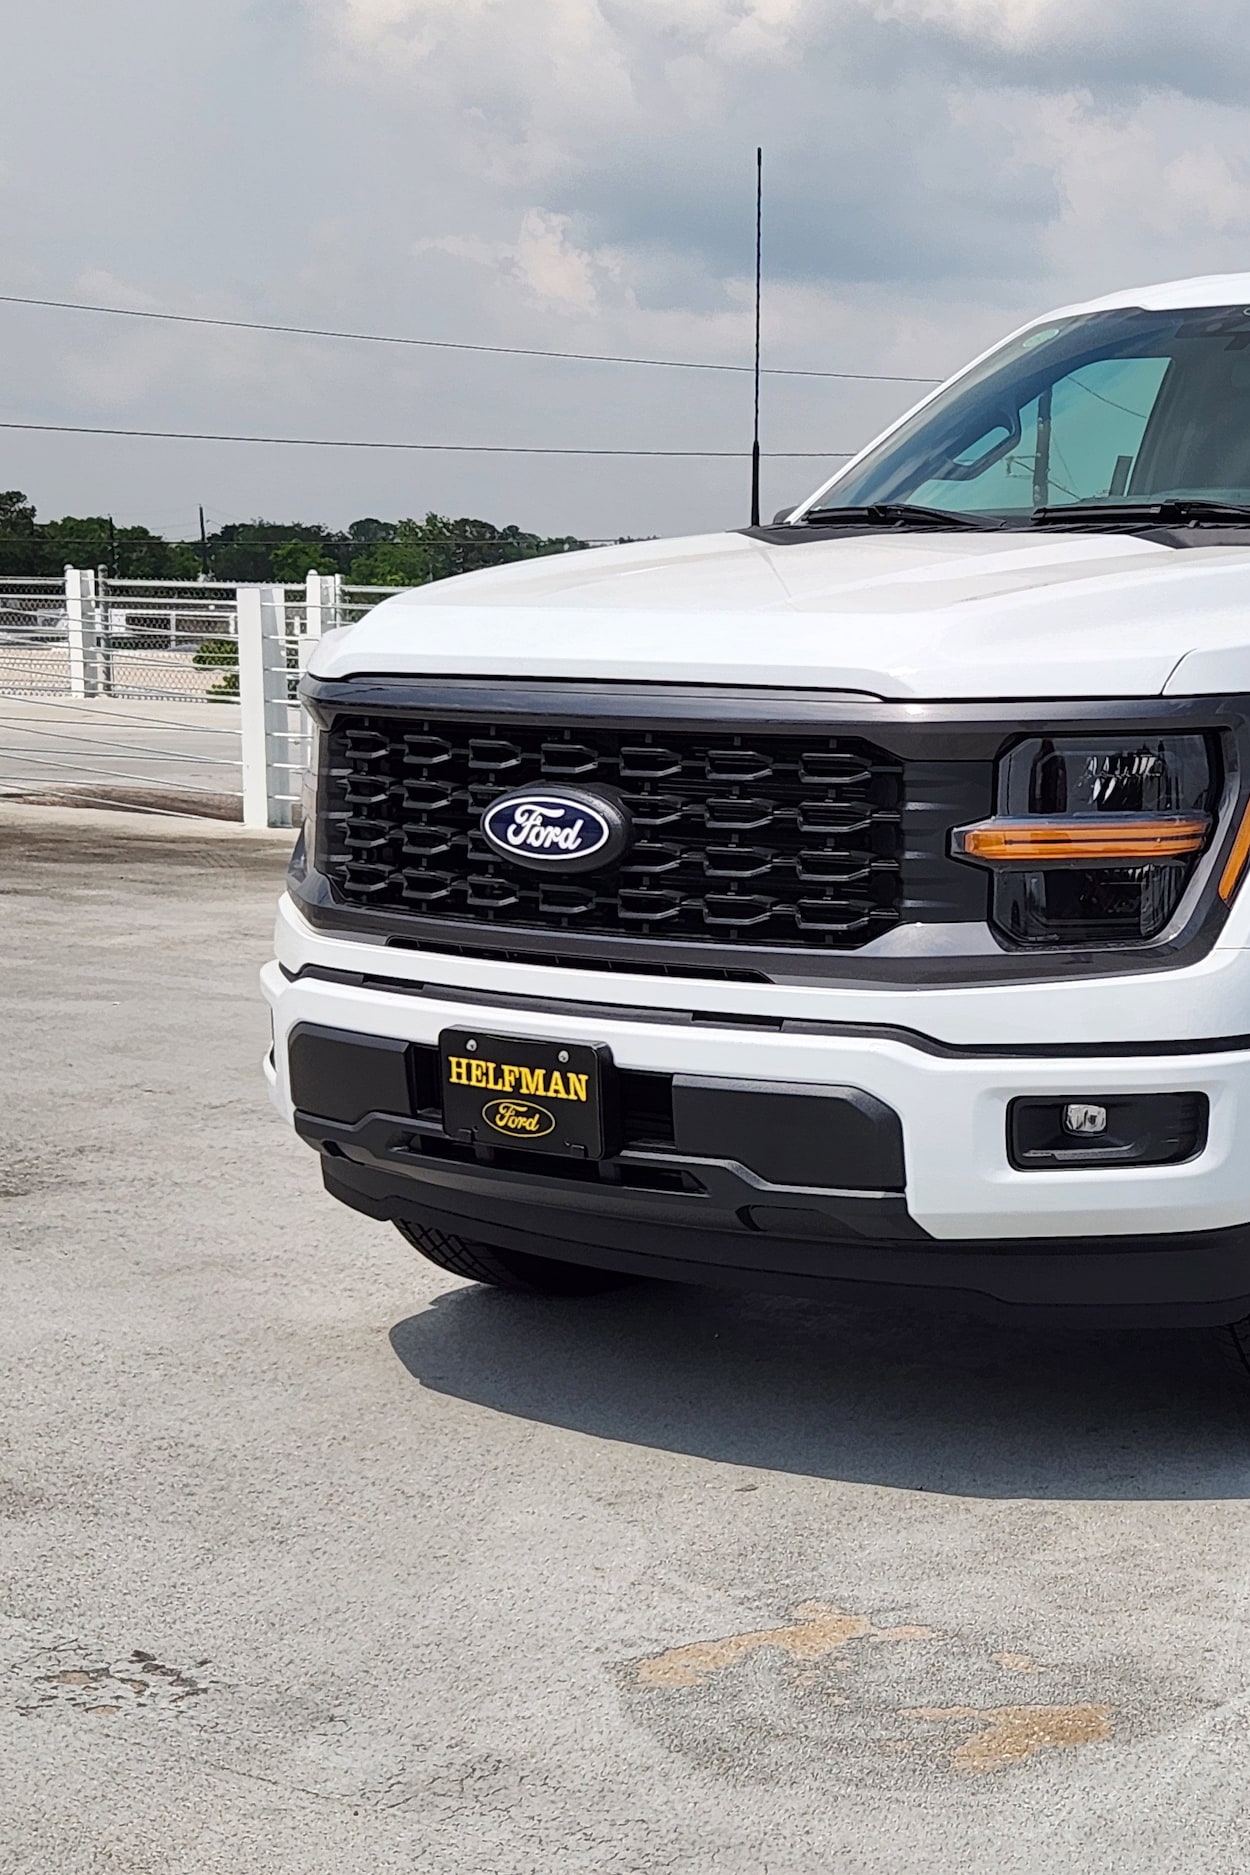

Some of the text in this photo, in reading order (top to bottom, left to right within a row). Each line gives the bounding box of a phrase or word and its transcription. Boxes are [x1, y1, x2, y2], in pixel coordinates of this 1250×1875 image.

[506, 804, 584, 850] Ford
[448, 1056, 589, 1102] HELFMAN
[495, 1102, 540, 1131] Ford
